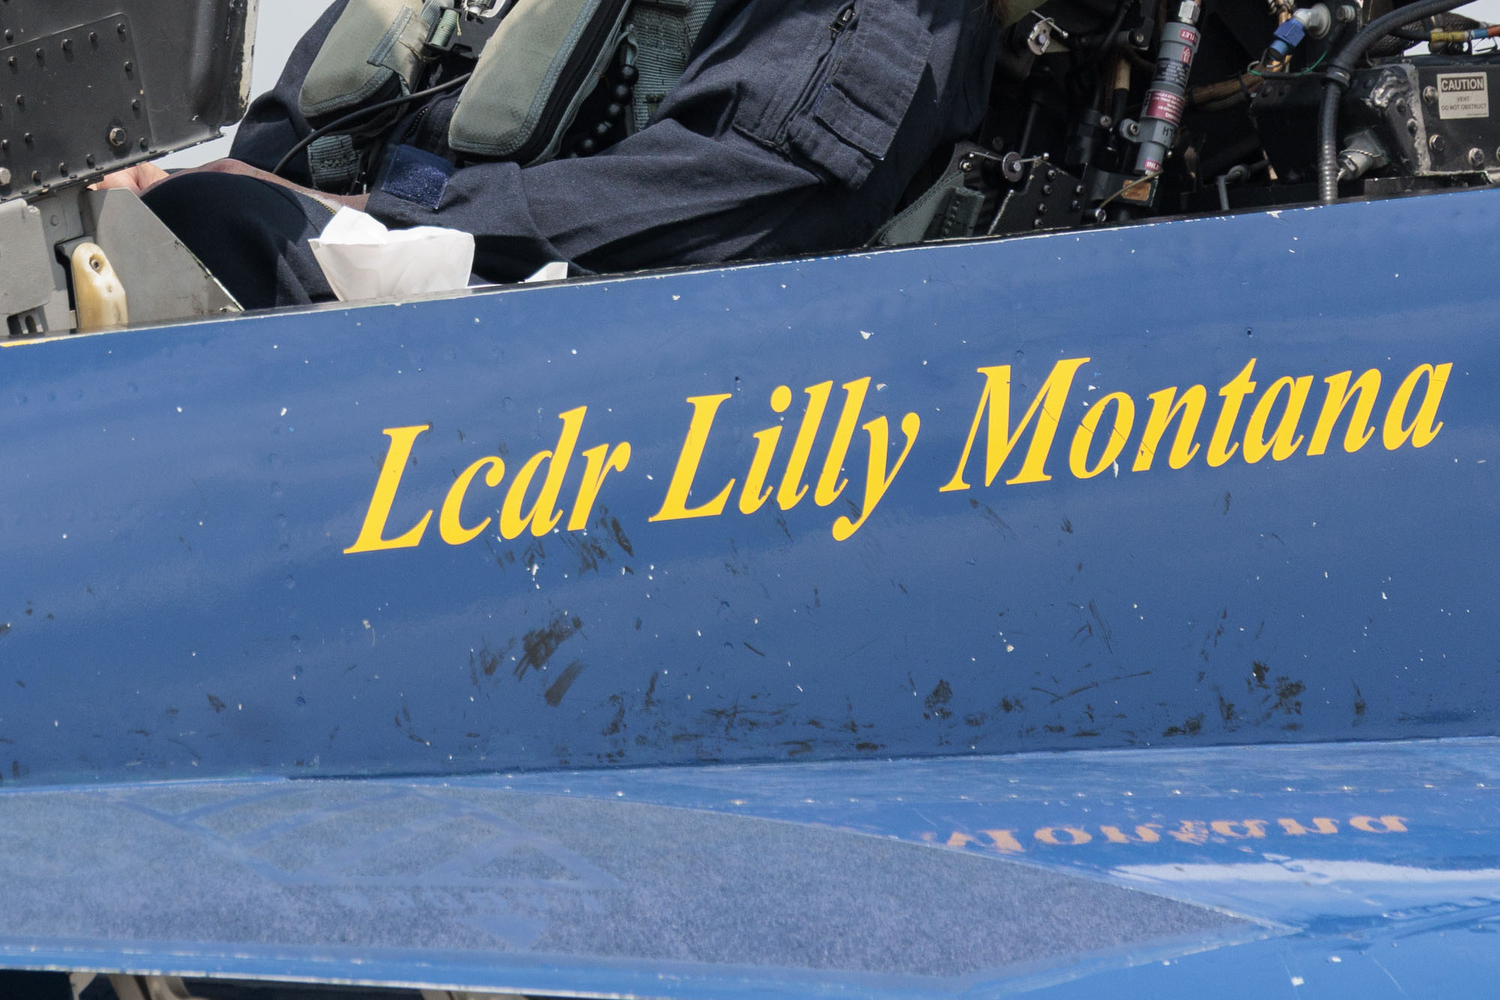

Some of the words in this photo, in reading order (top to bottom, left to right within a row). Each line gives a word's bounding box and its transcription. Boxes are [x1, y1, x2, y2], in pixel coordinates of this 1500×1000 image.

[1441, 78, 1484, 91] CAUTION
[343, 405, 632, 554] Lcdr
[648, 376, 921, 542] Lilly
[939, 357, 1453, 493] Montana
